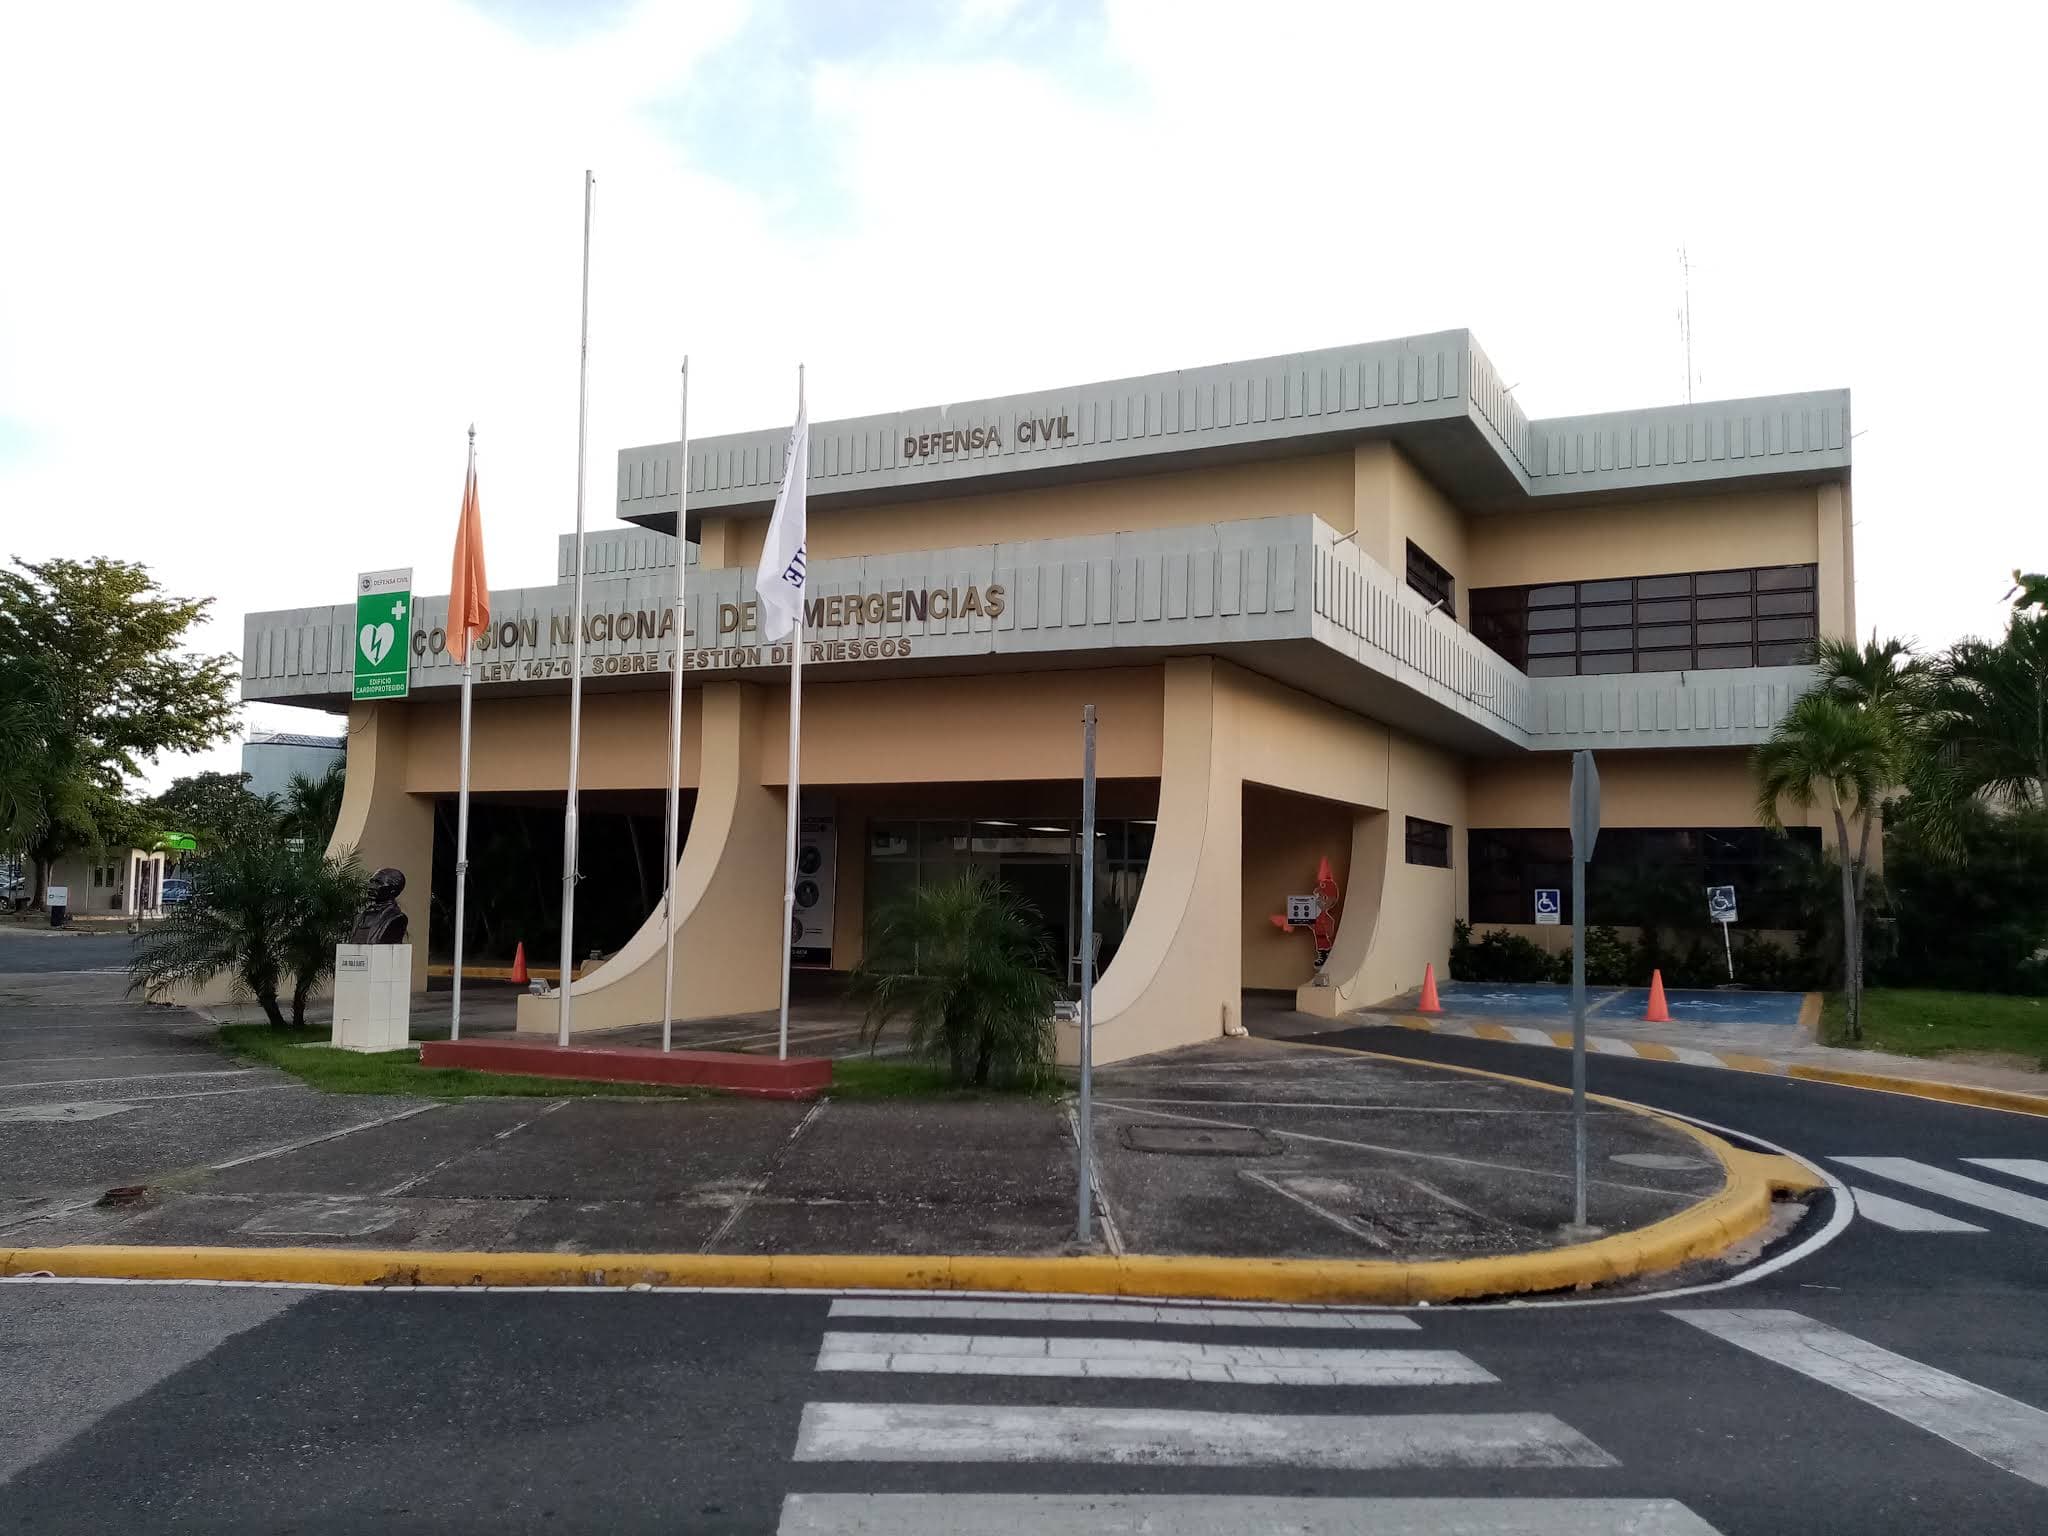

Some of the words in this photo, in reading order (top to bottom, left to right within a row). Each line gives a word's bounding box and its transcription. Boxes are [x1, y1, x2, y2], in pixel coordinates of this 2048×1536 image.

[904, 425, 1002, 458] DEFENSA
[1017, 415, 1075, 443] CIVIL
[550, 607, 695, 645] NACIONAL
[719, 600, 758, 634] DE
[803, 583, 1006, 628] MERGENCIAS
[369, 677, 392, 686] EDIFICIO
[480, 663, 516, 682] LEY
[592, 654, 659, 675] SOBRE
[810, 637, 912, 662] RIESGOS
